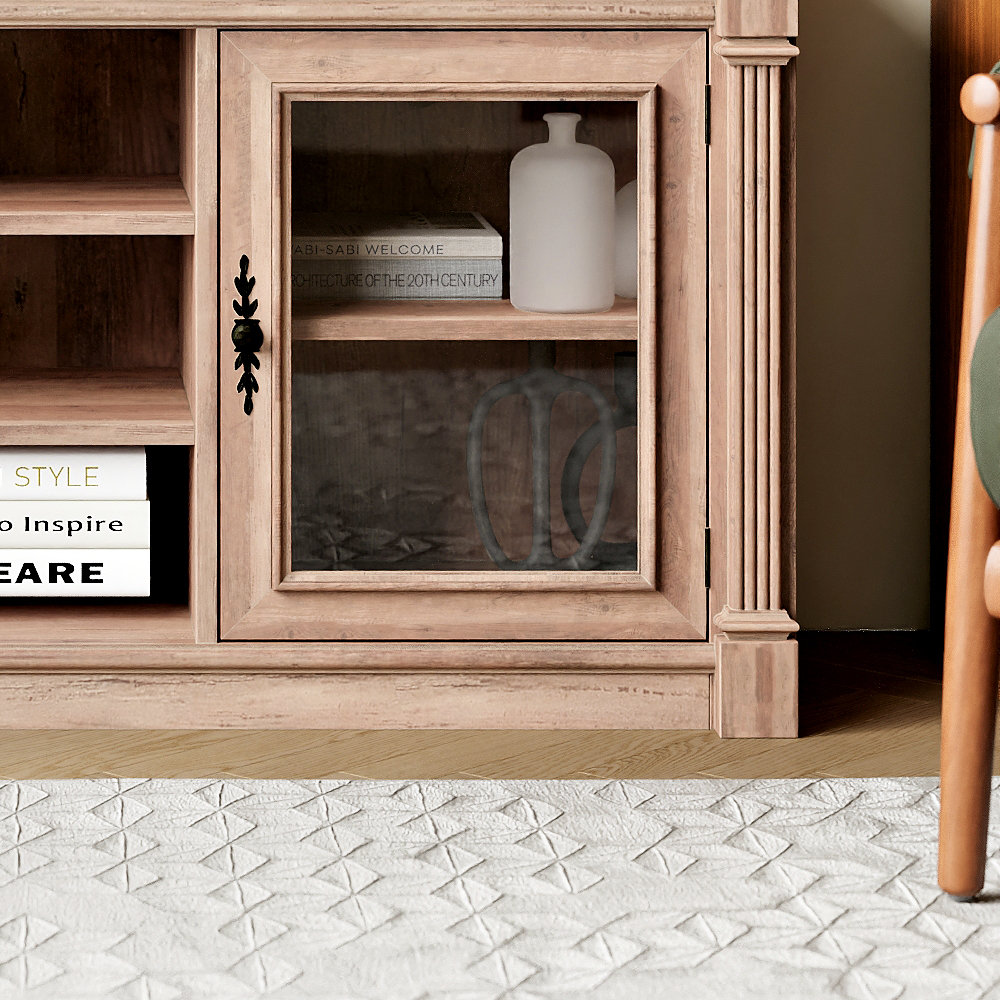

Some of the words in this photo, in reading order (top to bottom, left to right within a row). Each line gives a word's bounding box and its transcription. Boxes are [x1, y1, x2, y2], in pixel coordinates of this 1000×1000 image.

[291, 244, 360, 255] ABI-SABI
[365, 244, 444, 255] WELCOME
[291, 273, 363, 288] RCHITECTURE
[365, 273, 381, 288] OF
[383, 273, 405, 288] THE
[407, 273, 439, 288] 20TH
[441, 273, 499, 288] CENTURY
[14, 466, 100, 488] STYLE
[24, 515, 124, 537] Inspire
